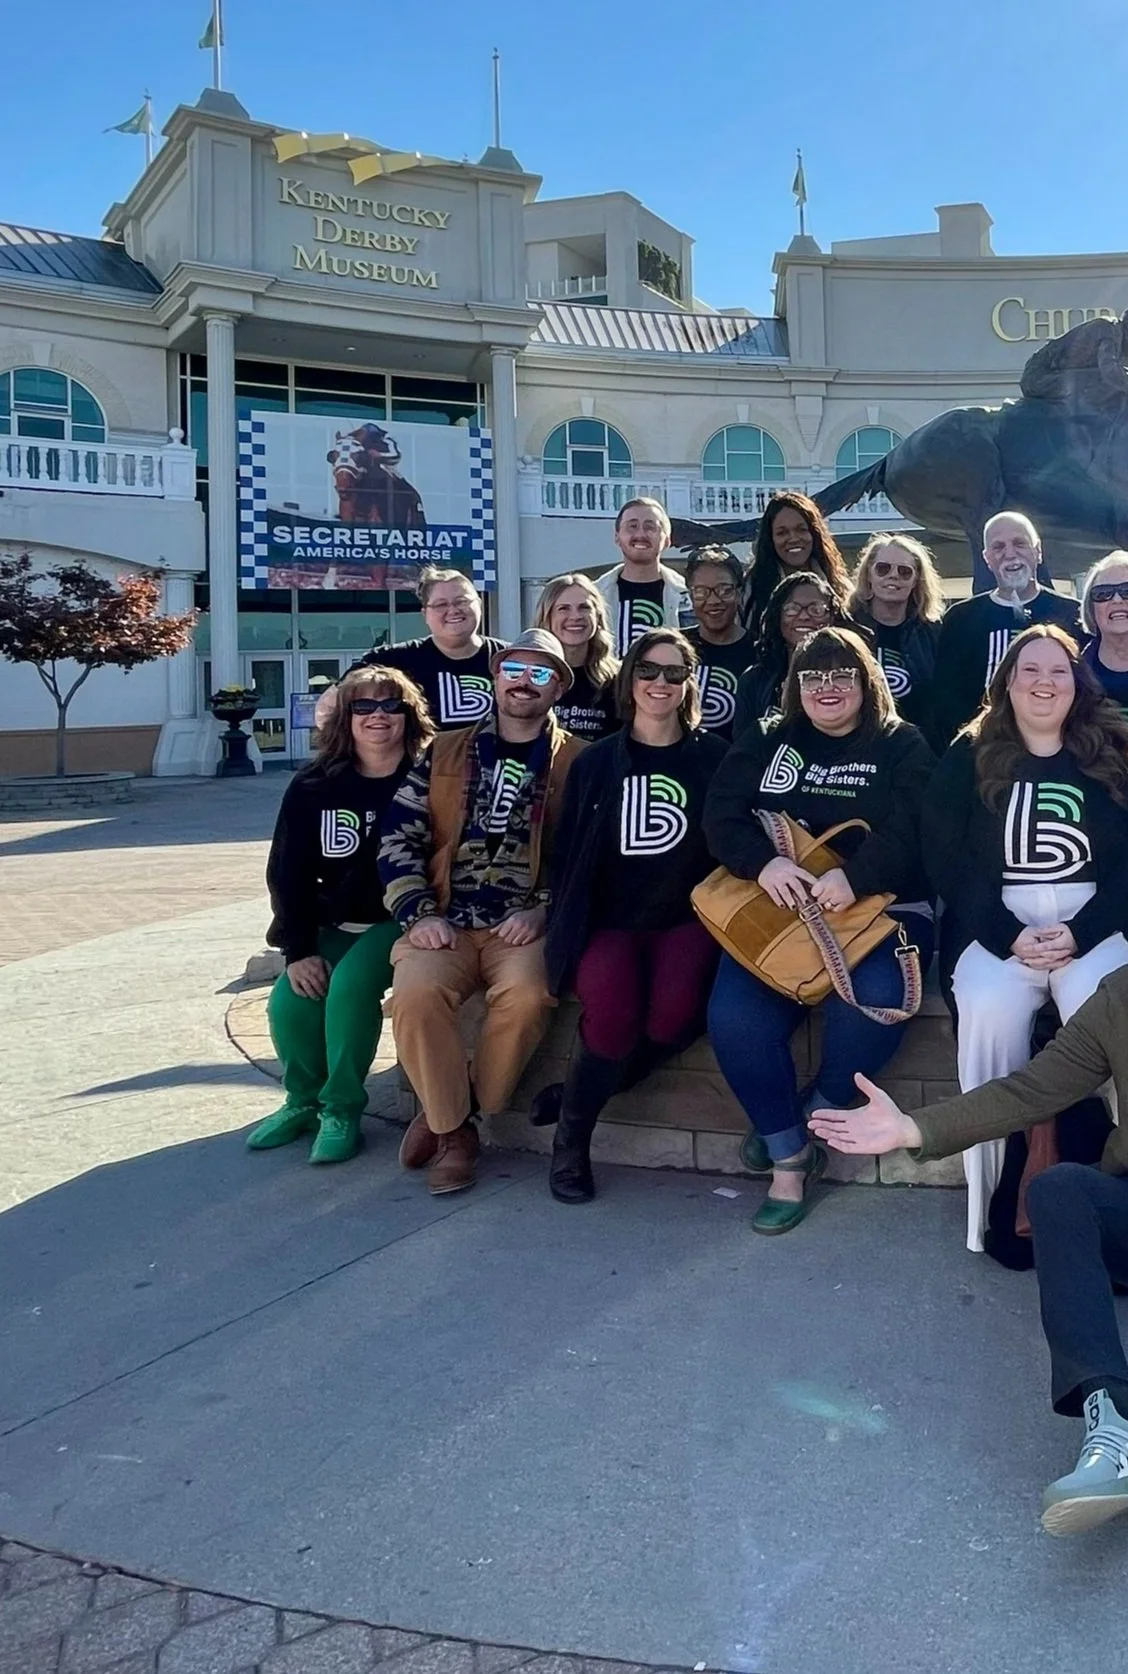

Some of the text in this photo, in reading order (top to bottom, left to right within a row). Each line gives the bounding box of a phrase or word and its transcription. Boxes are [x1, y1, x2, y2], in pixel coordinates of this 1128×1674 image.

[278, 176, 451, 229] KENTUCKY
[313, 215, 419, 255] DERBY
[292, 244, 439, 289] MUSEUM
[273, 525, 467, 548] SECRETARIAT
[293, 547, 452, 560] AMERICA'S HORSE
[804, 771, 824, 785] Big
[809, 762, 877, 776] Big Brothers
